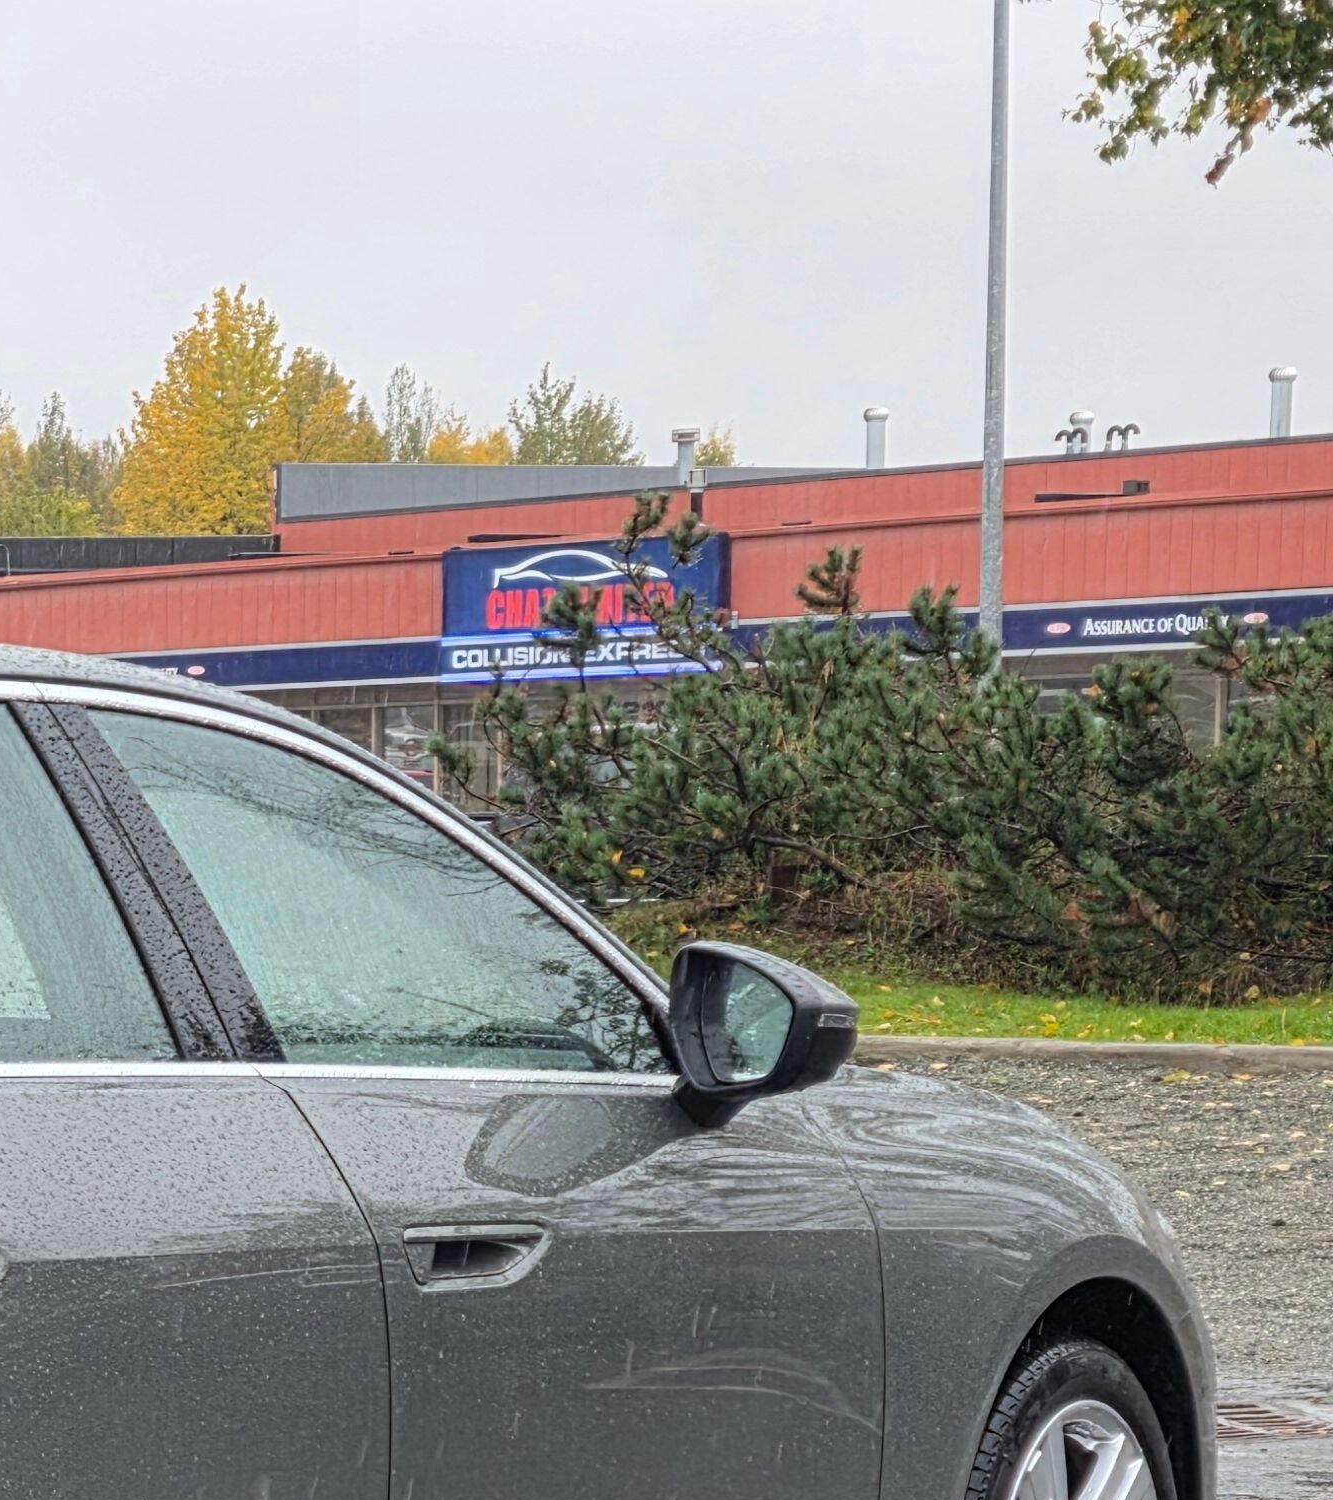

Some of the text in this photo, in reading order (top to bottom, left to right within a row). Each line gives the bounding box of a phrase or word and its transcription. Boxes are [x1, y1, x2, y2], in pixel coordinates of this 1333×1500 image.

[1083, 618, 1155, 636] ASSURANCE
[1175, 613, 1230, 636] QUALY
[452, 640, 704, 669] COLLISION EXPRES
